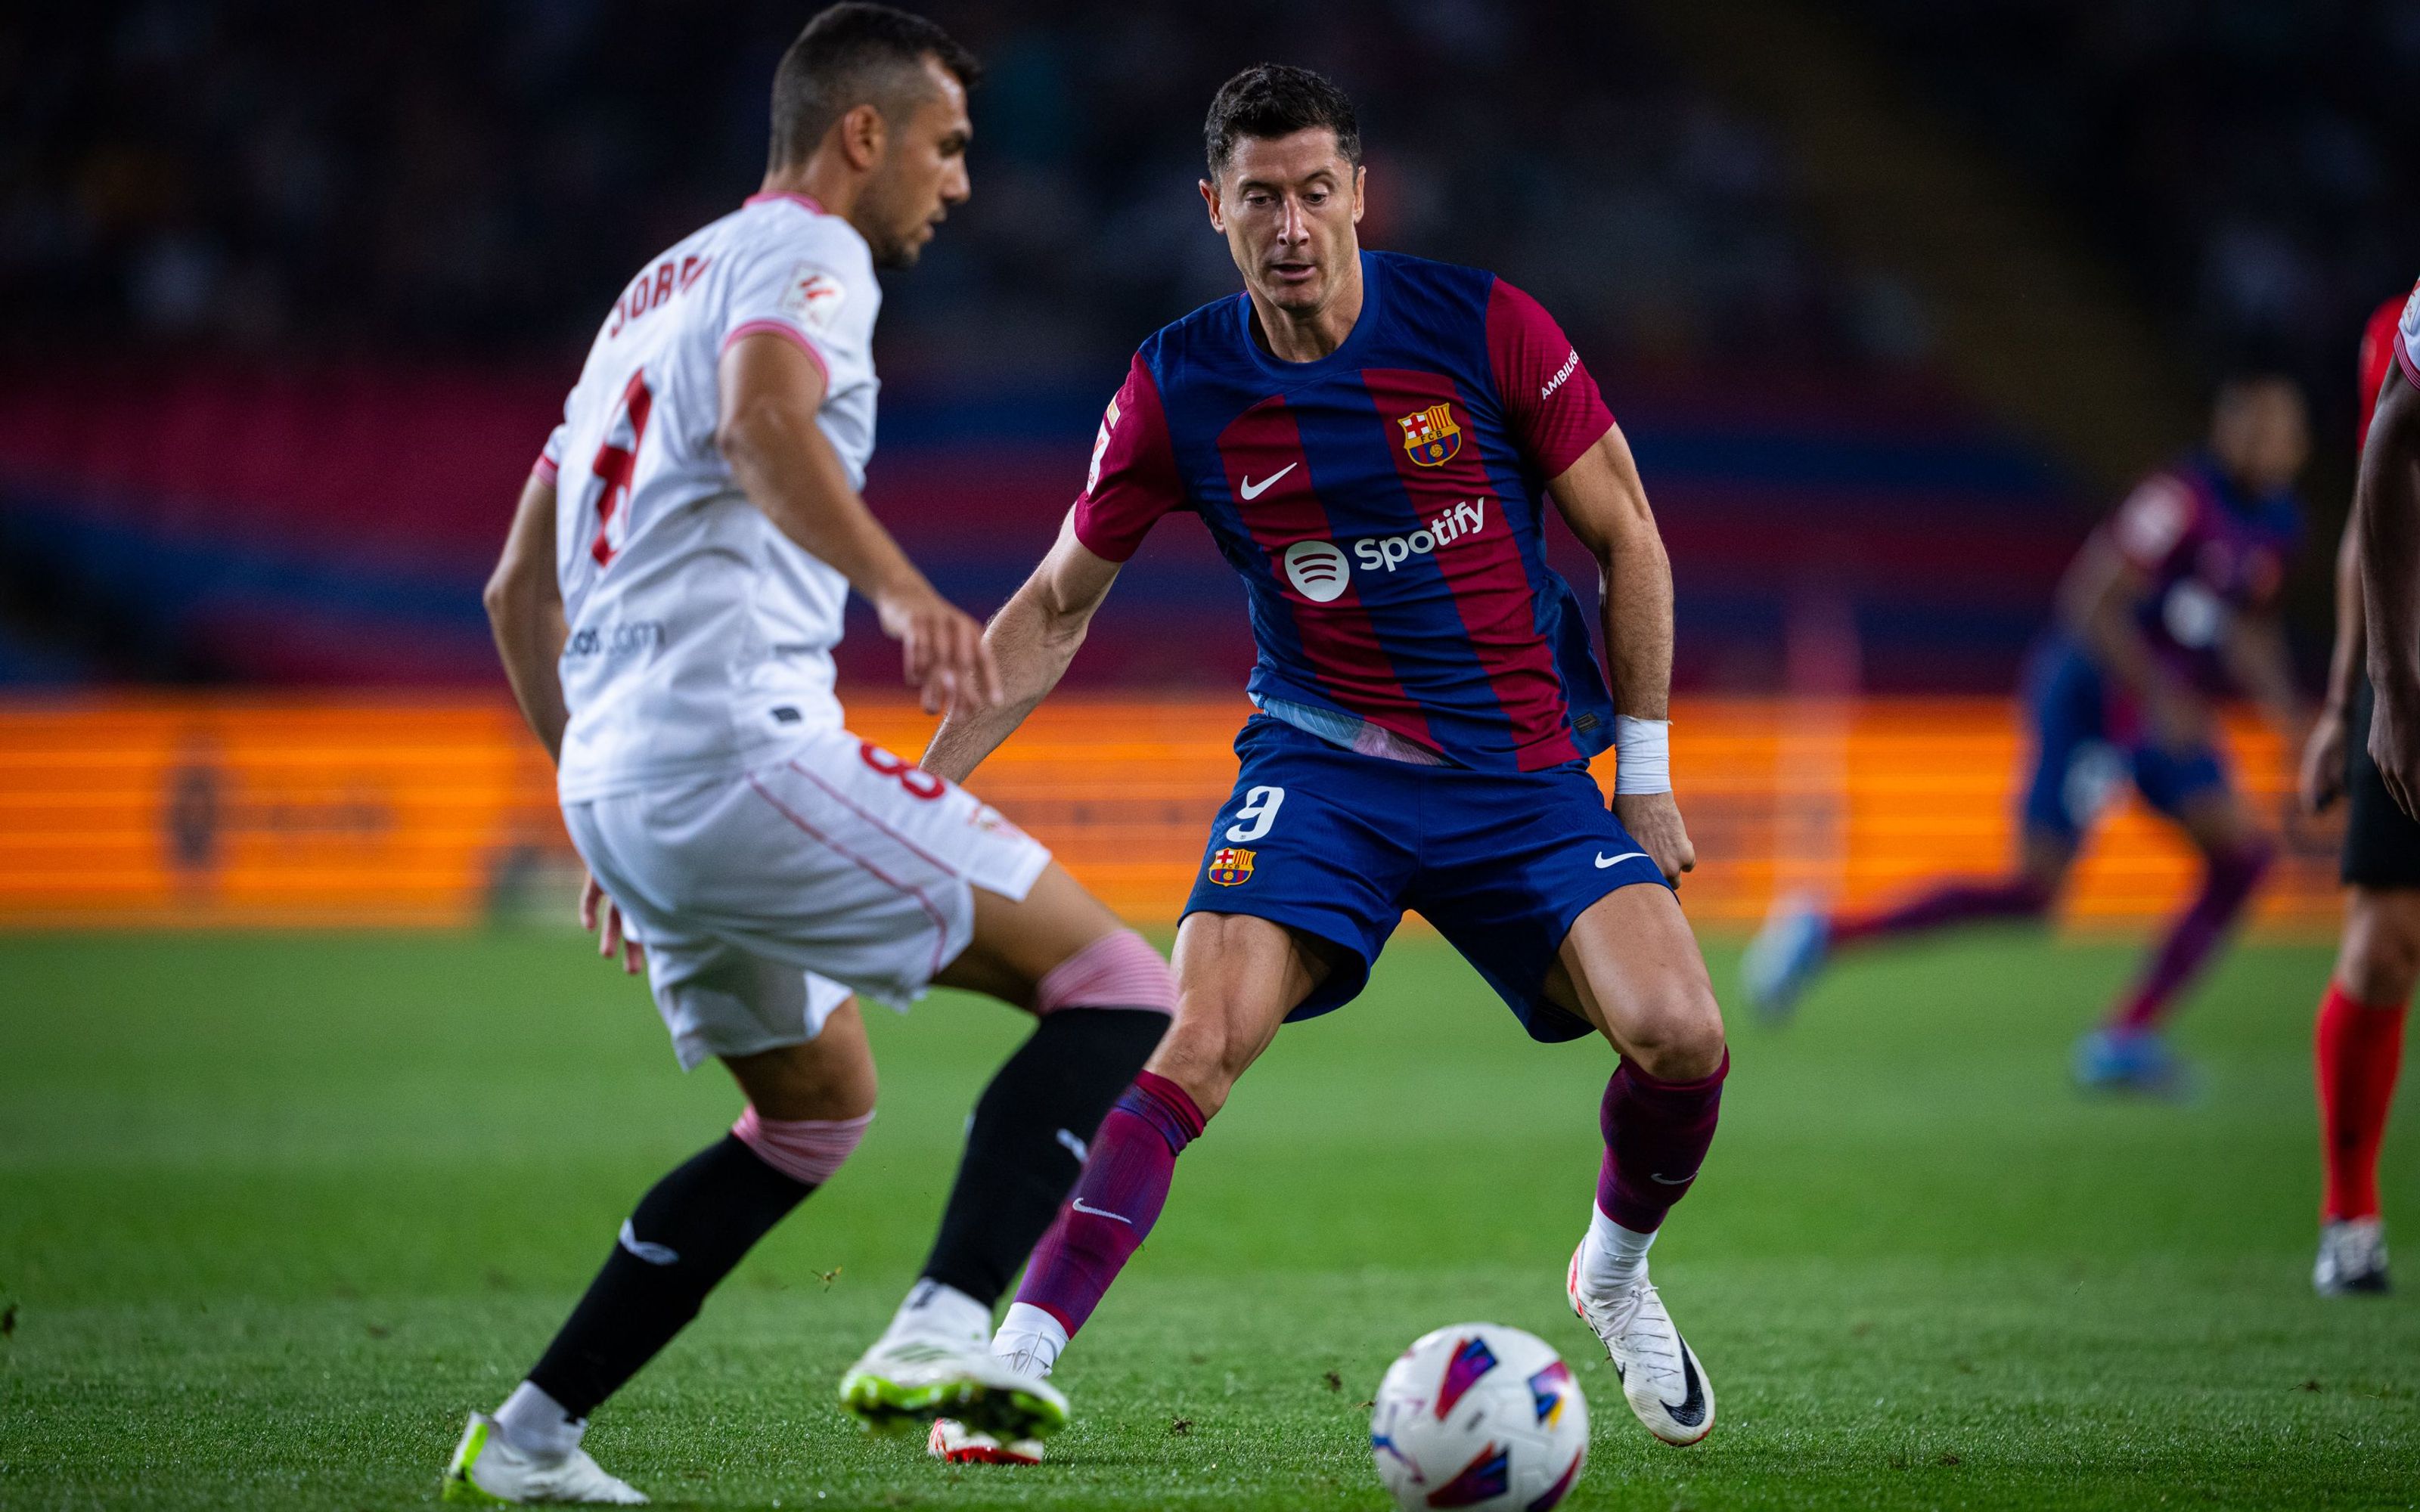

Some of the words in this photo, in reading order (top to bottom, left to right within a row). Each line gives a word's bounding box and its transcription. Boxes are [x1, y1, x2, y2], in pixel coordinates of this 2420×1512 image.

[1354, 497, 1485, 572] Spotify
[860, 739, 946, 800] 8
[1226, 785, 1285, 842] 9
